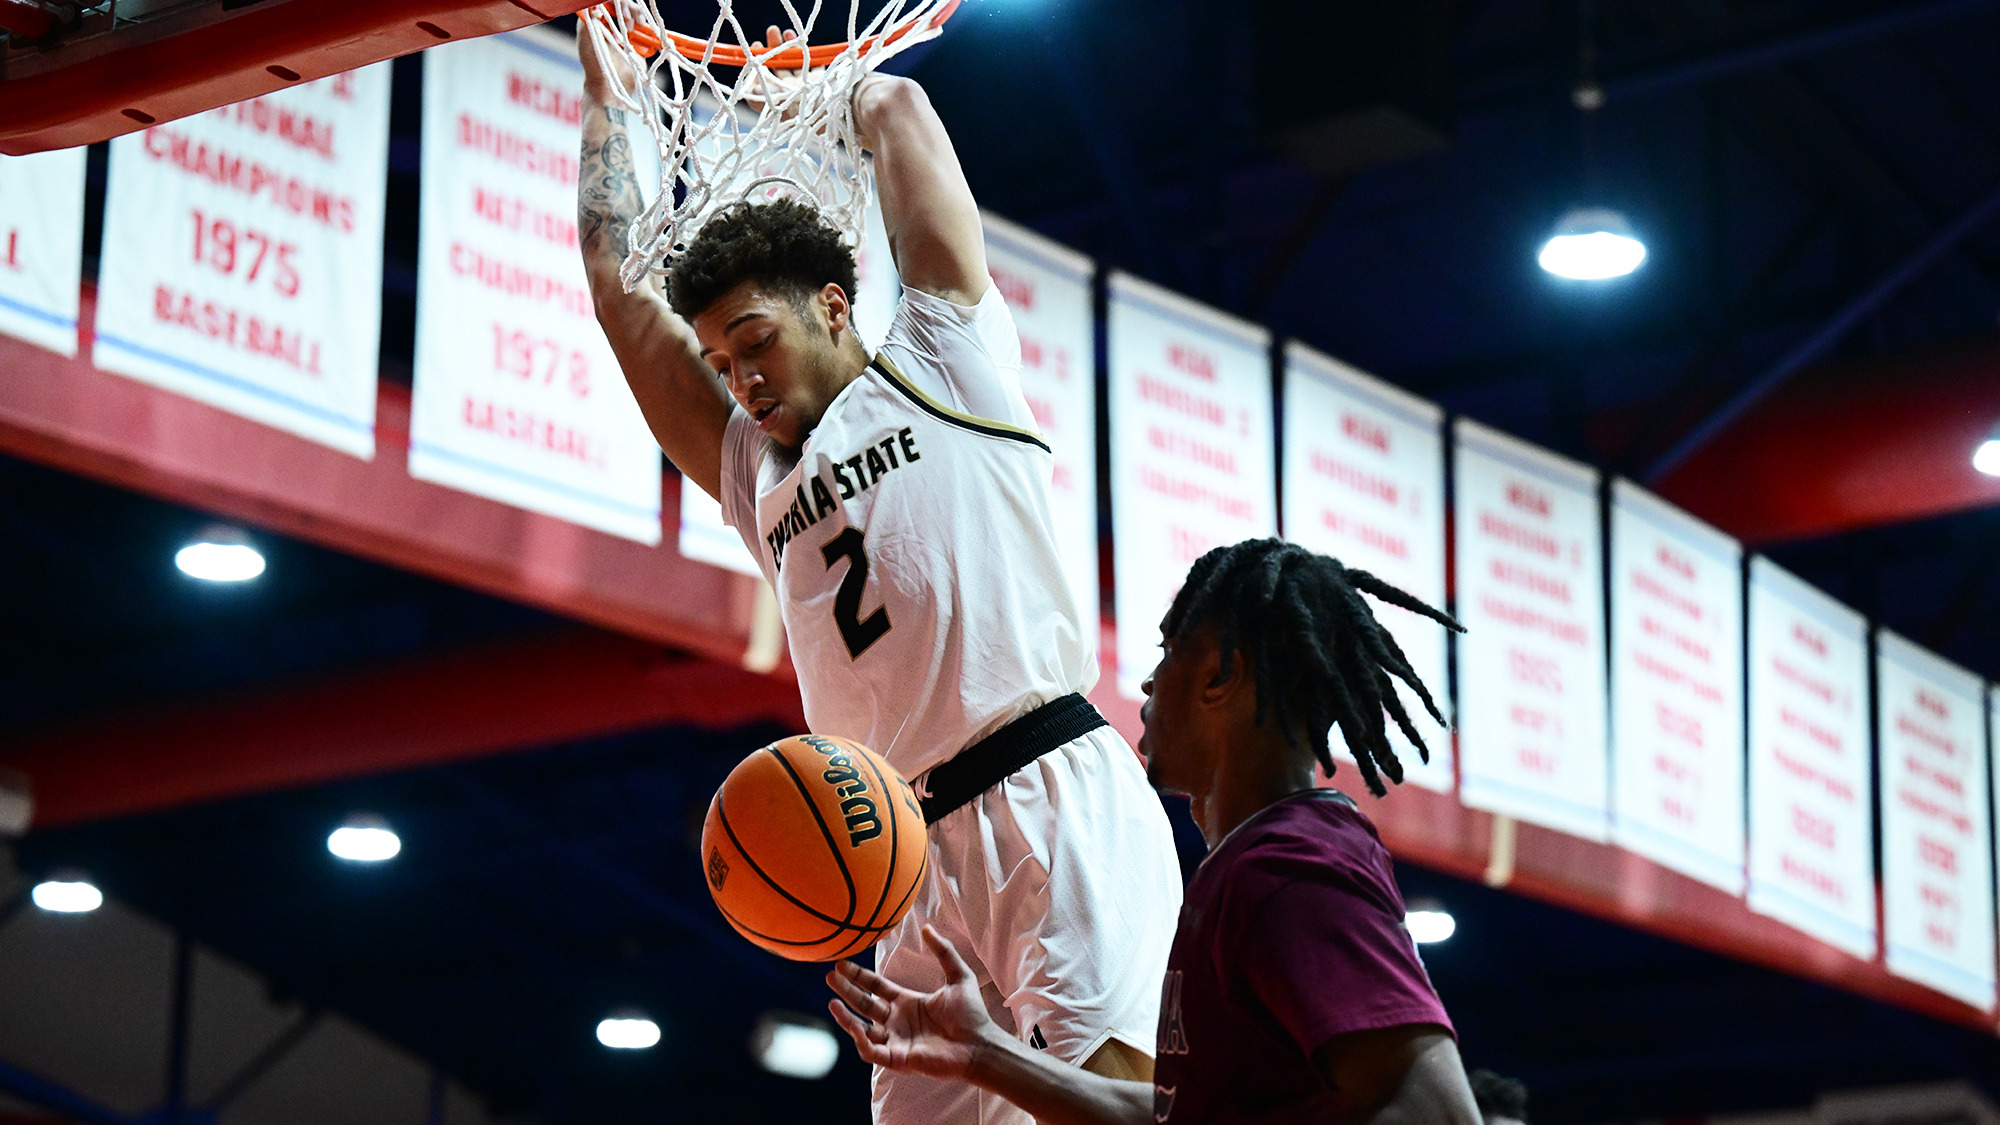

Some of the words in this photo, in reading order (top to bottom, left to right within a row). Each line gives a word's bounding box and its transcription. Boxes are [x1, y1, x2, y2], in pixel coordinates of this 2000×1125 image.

[144, 126, 355, 234] CHAMPIONS
[190, 208, 301, 299] 1975
[154, 284, 322, 377] BASEBALL
[832, 426, 920, 502] STATE
[819, 525, 893, 662] 2
[798, 735, 883, 849] Wilson
